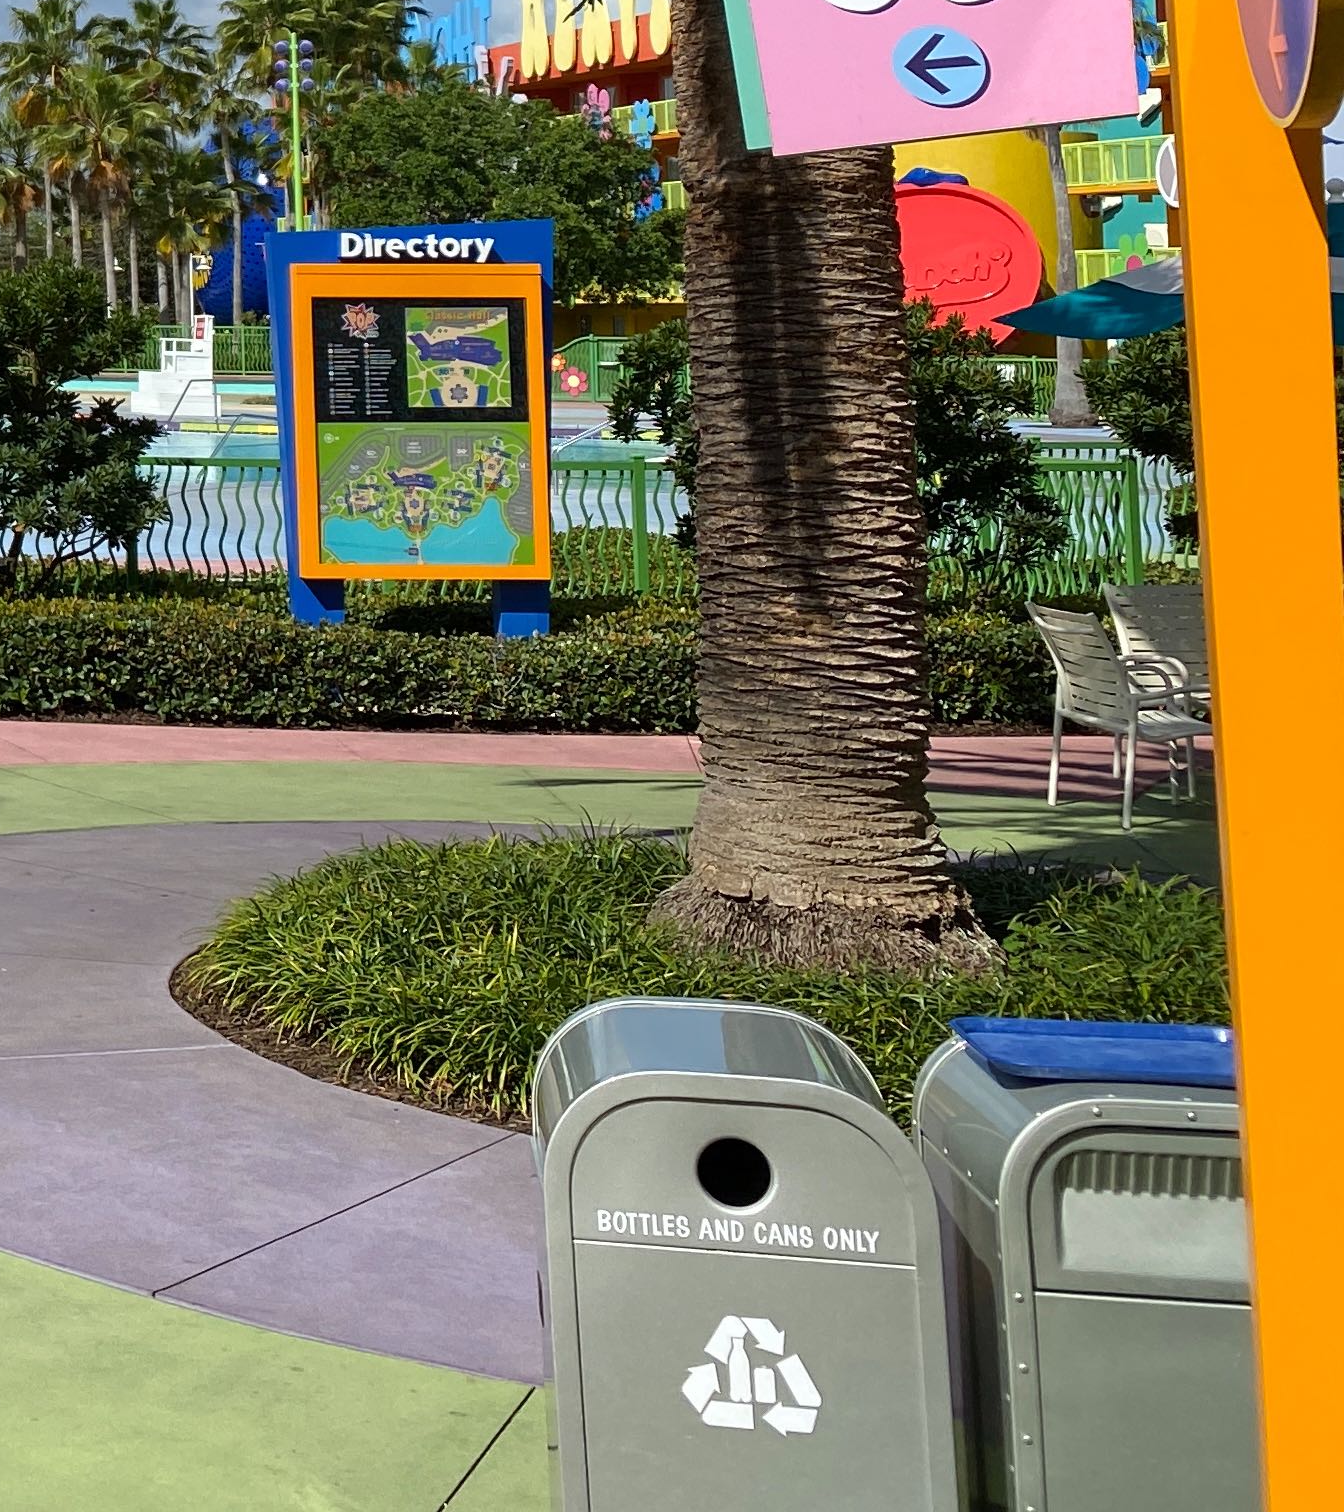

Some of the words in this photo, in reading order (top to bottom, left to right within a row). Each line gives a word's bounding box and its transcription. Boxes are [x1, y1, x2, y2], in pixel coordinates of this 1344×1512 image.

[340, 232, 495, 263] Directory
[597, 1209, 691, 1238] BOTTLES
[698, 1218, 745, 1243] AND
[753, 1222, 814, 1249] CANS
[823, 1226, 880, 1254] ONLY
